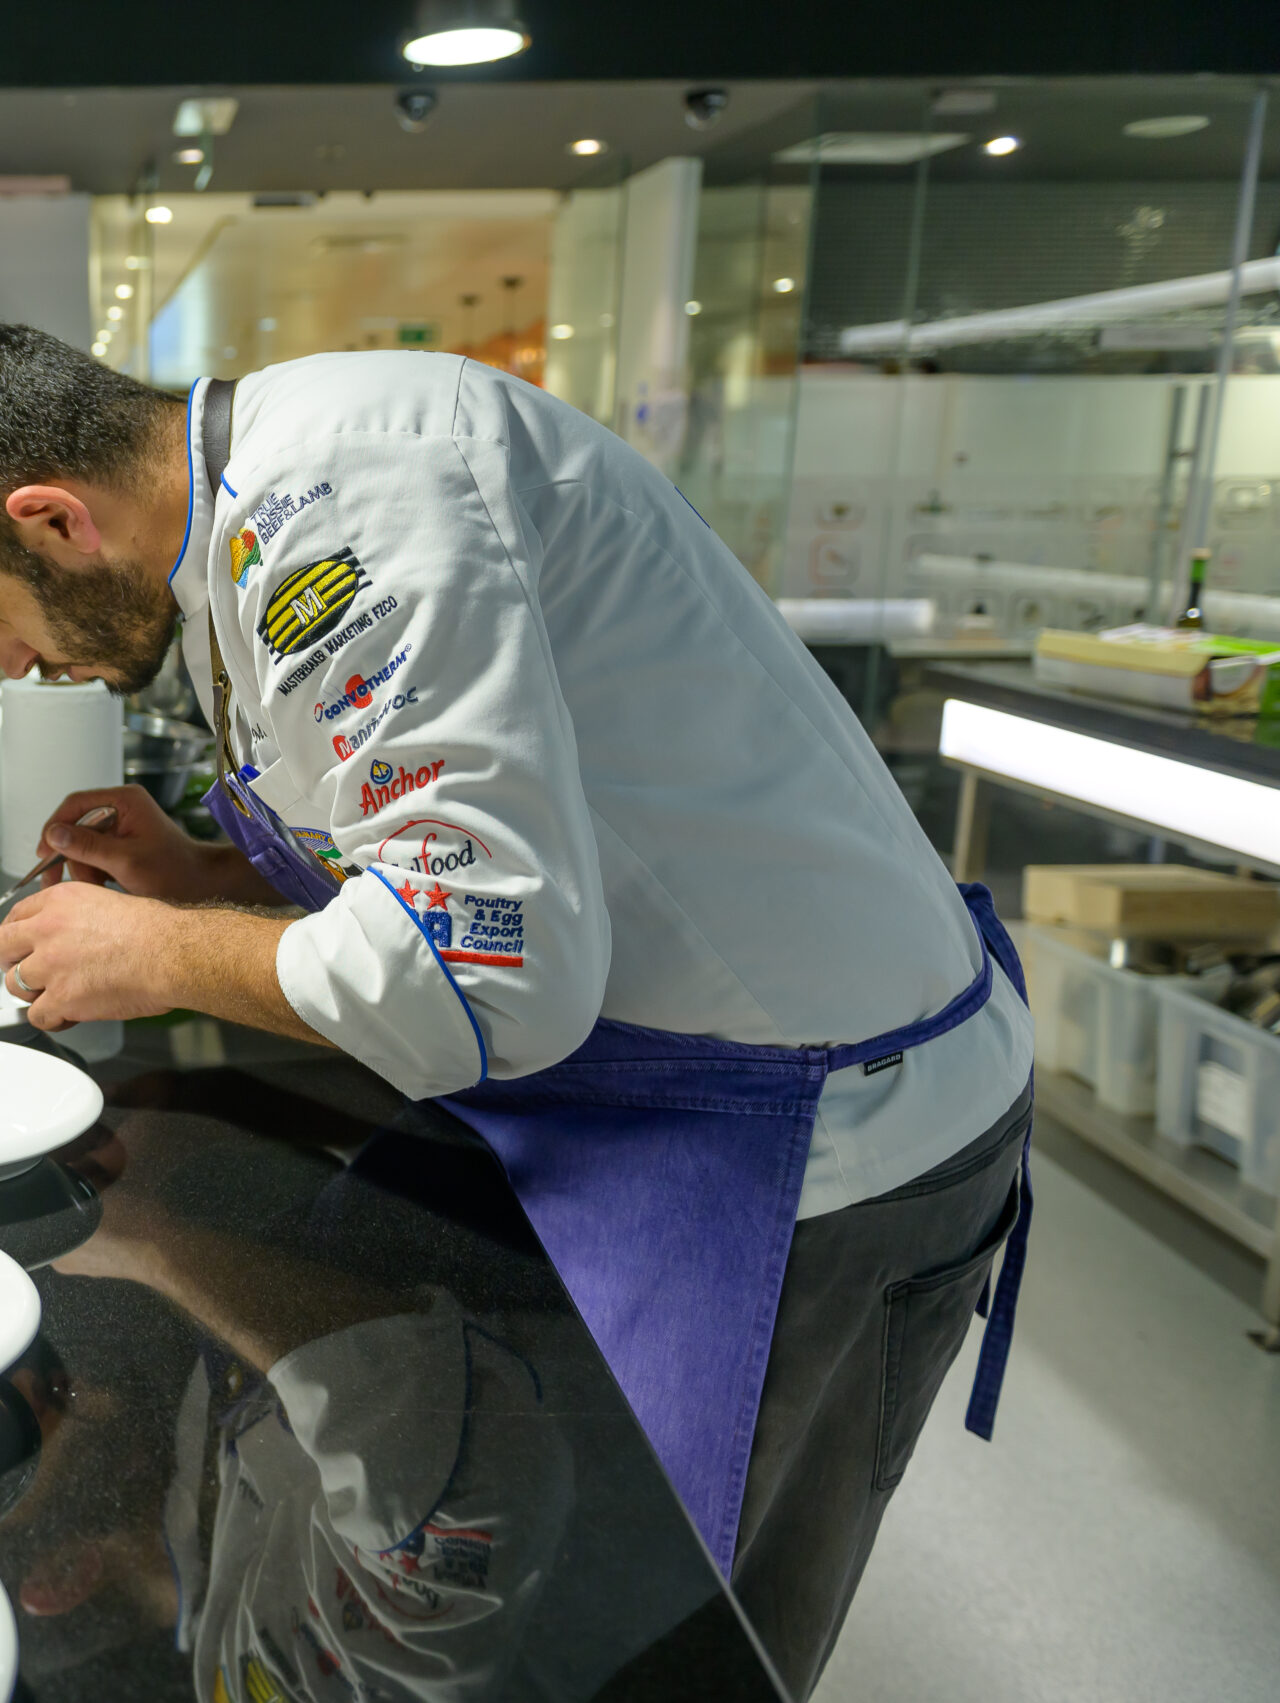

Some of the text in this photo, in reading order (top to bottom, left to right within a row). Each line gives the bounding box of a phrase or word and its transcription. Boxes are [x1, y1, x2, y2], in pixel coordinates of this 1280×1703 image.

[250, 492, 279, 524] TRUE
[257, 493, 294, 535] AUSSIE
[290, 586, 327, 625] M
[325, 613, 373, 656] MARKETING
[371, 595, 398, 620] FZCO
[359, 759, 445, 816] Anchor
[464, 894, 523, 912] Poultry
[474, 909, 523, 926] & Egg
[460, 935, 524, 953] Council
[469, 922, 524, 939] Export
